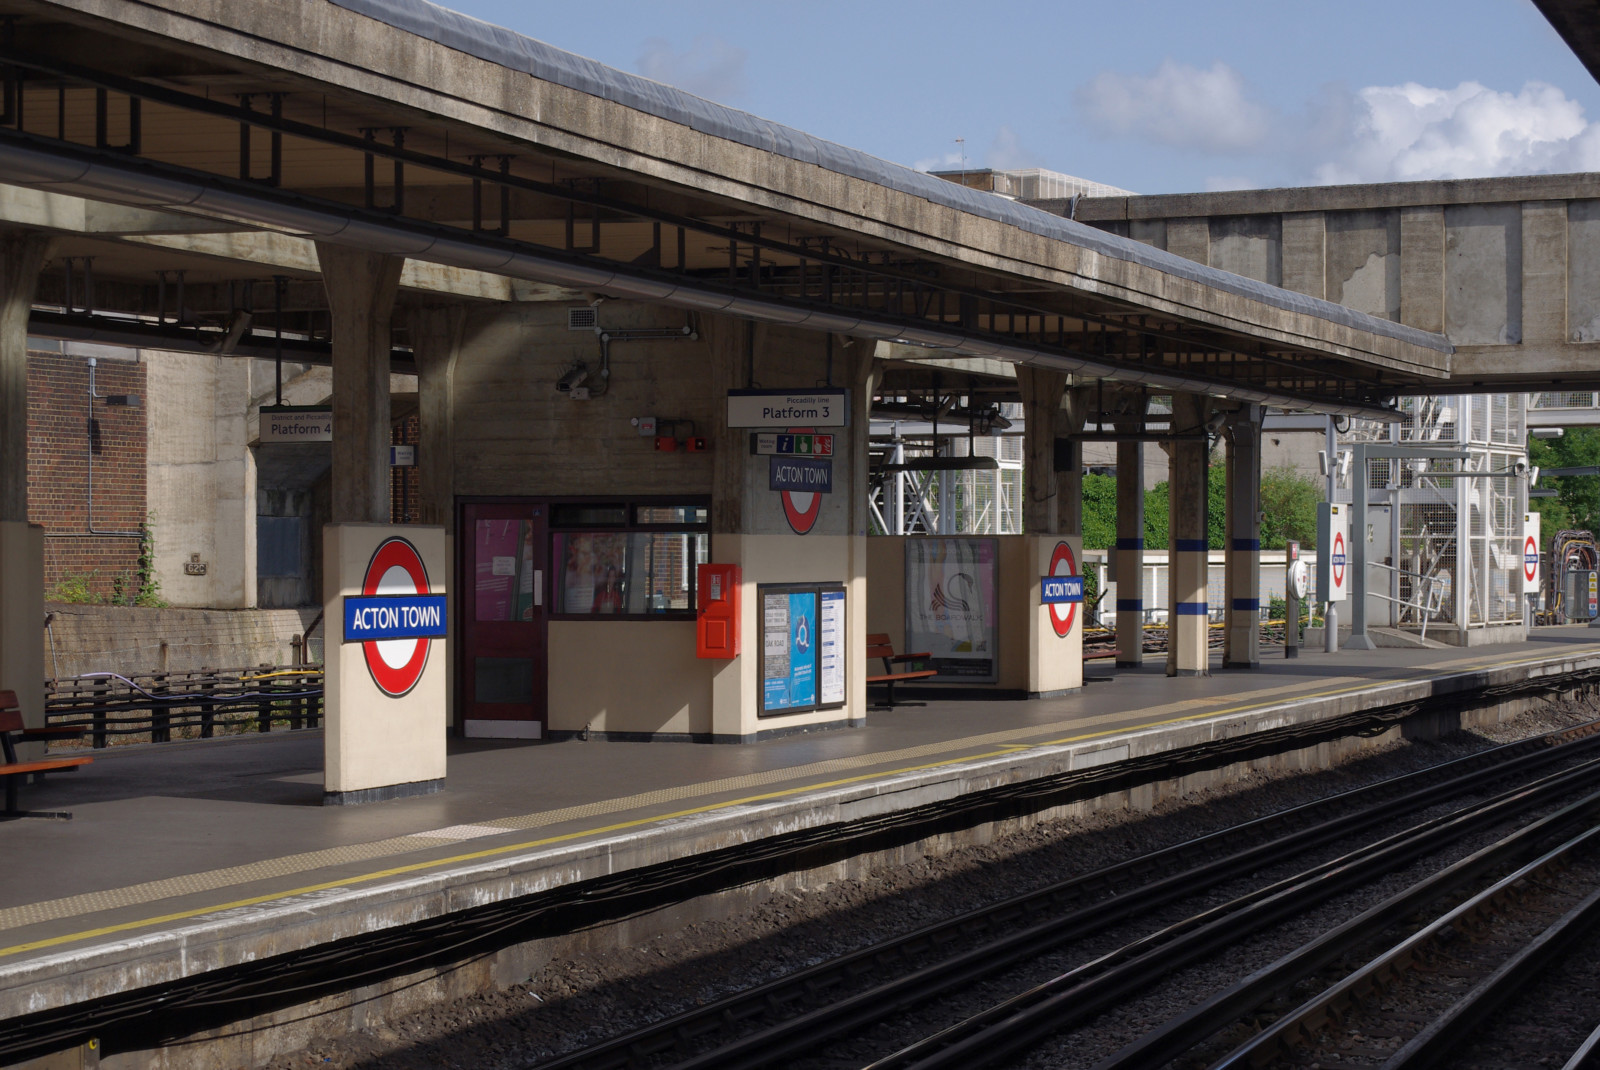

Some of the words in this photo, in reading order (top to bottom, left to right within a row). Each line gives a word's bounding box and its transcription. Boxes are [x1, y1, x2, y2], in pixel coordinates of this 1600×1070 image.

[762, 407, 818, 419] Platform
[822, 406, 830, 418] 3
[271, 423, 321, 435] Platform
[324, 423, 332, 434] 4
[775, 465, 804, 484] ACTON
[804, 467, 828, 485] TOWN
[1044, 583, 1064, 597] ACTON
[1064, 582, 1081, 596] TOWN
[352, 607, 399, 630] ACTON
[401, 605, 440, 628] TOWN
